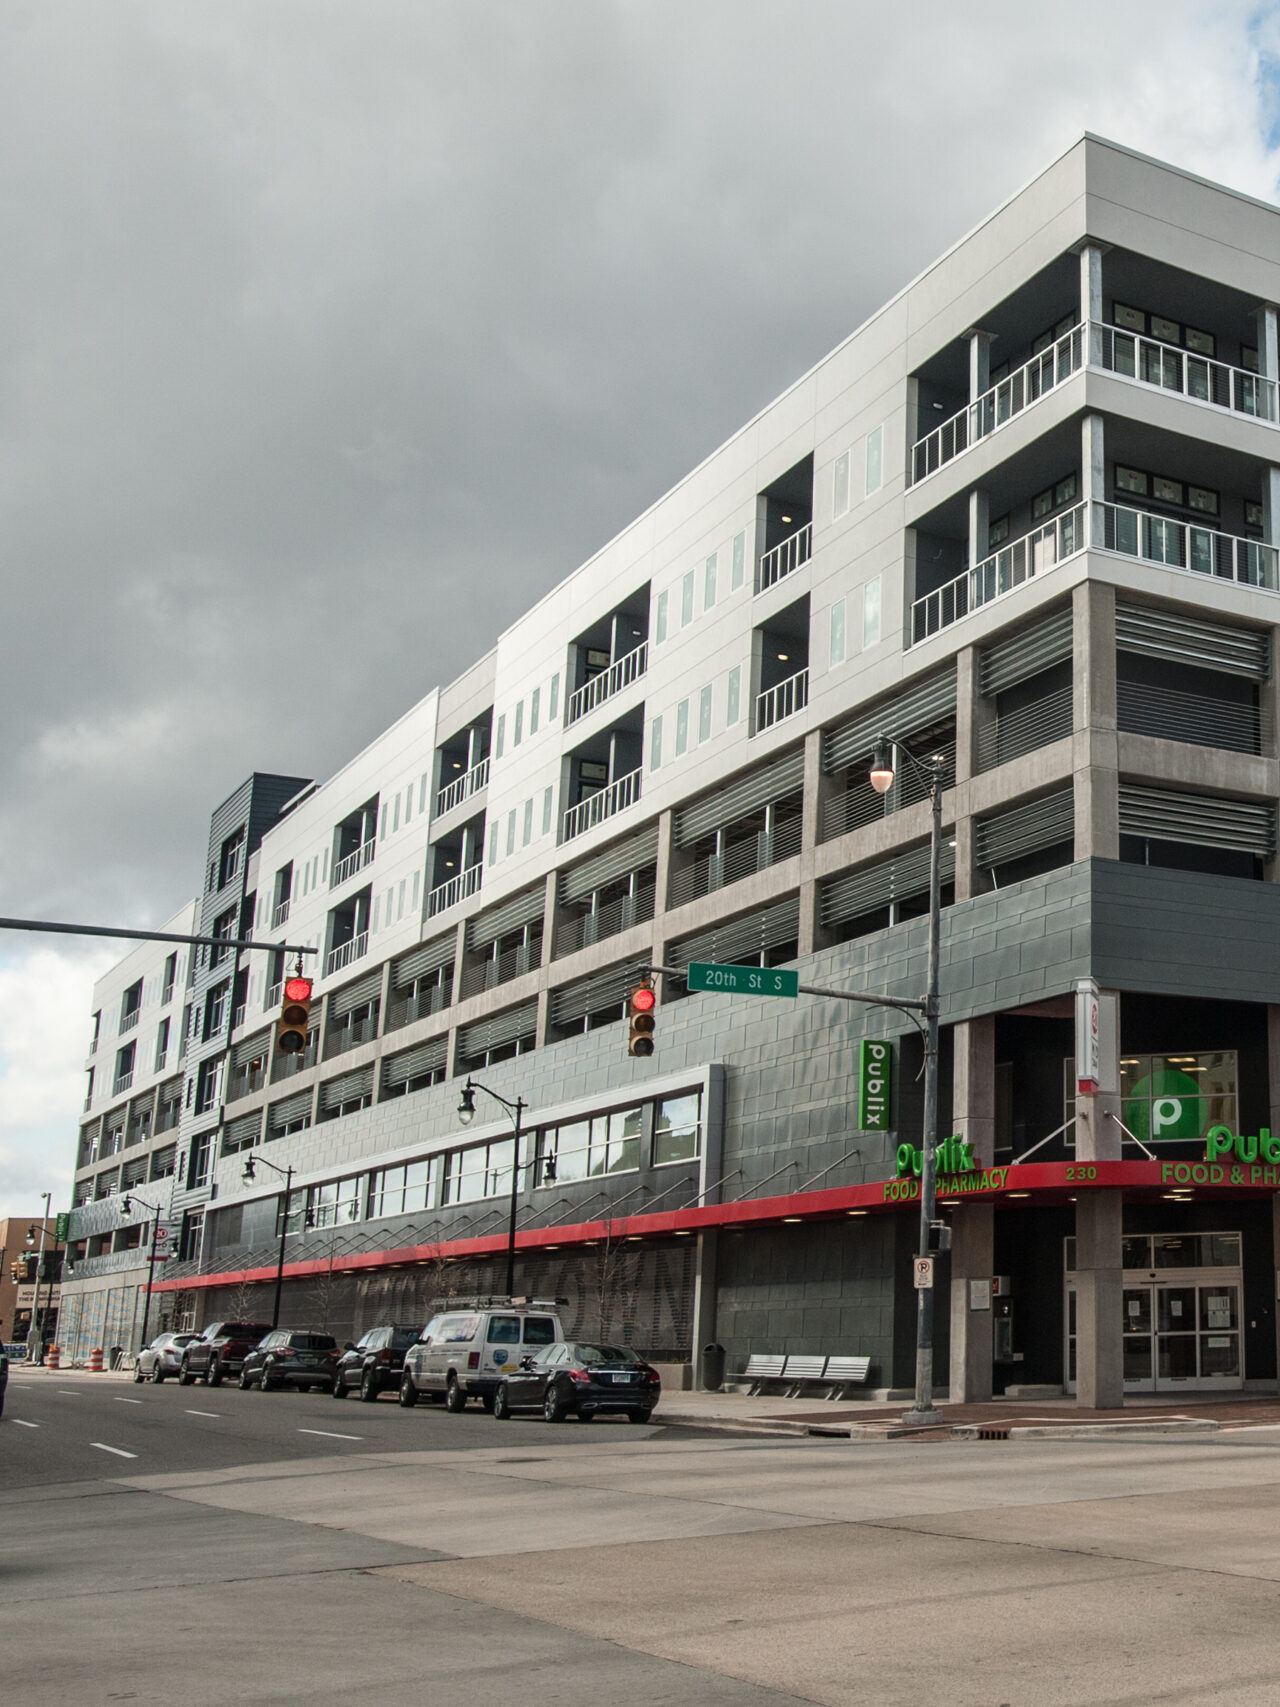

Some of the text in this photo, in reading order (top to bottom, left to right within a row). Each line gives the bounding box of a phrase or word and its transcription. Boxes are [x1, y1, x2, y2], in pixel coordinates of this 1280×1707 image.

[705, 970, 783, 990] 20th St S
[866, 1044, 886, 1125] Publix
[883, 1168, 1009, 1201] FOOD PHARMACY
[1066, 1167, 1097, 1181] 230
[1161, 1163, 1224, 1184] FOOD
[1230, 1165, 1245, 1185] &
